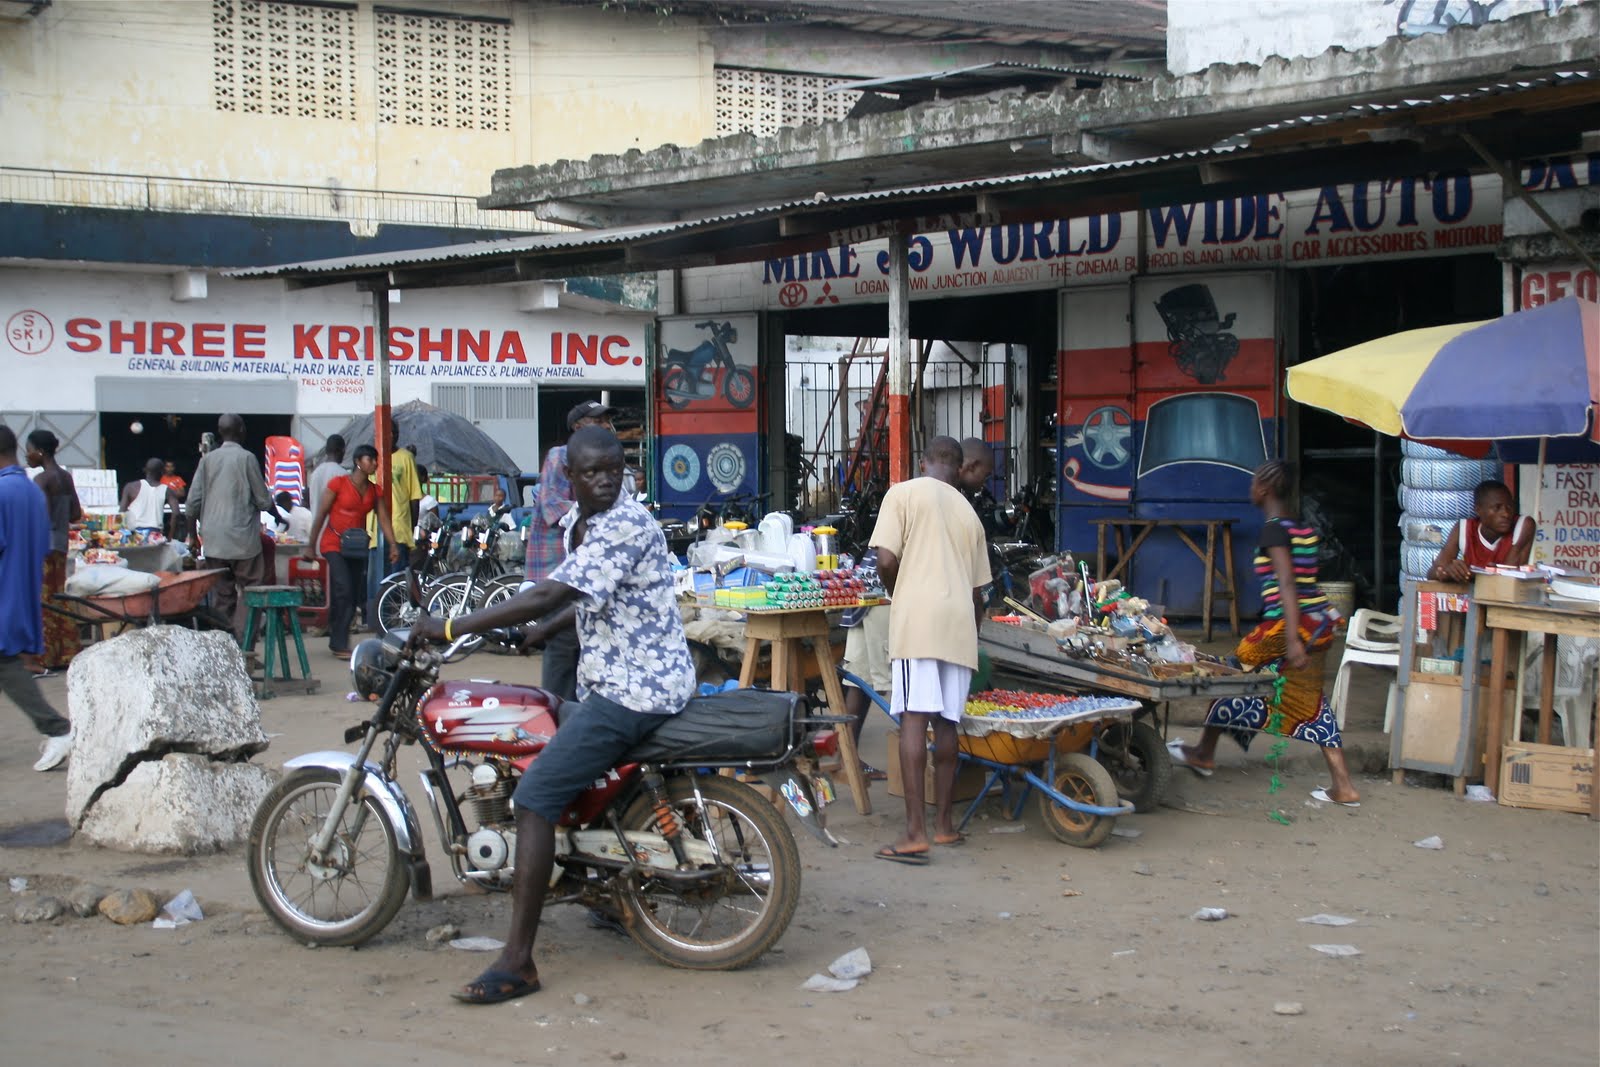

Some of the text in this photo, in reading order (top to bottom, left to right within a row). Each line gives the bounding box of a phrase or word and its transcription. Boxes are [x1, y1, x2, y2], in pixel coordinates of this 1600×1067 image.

[947, 211, 1122, 269] WORLD
[1149, 192, 1285, 248] WIDE
[1305, 169, 1473, 235] AUTO
[1292, 240, 1321, 260] CAR
[932, 272, 987, 290] JUNCTION
[992, 265, 1042, 284] ADJACENT
[1048, 262, 1071, 279] THE
[1124, 252, 1178, 271] BUHROD
[65, 317, 643, 366] SHREE KRISHNA INC.
[128, 358, 176, 371] GENERAL
[180, 360, 229, 373] BUILDING
[293, 363, 325, 375] HARD
[366, 364, 427, 376] ETRICAL
[430, 365, 488, 377] APPLIANCES
[489, 365, 497, 377] &
[500, 366, 544, 378] PLUMBING
[545, 367, 585, 378] MATERIAL
[1555, 472, 1594, 490] FAST
[1555, 528, 1567, 543] ID
